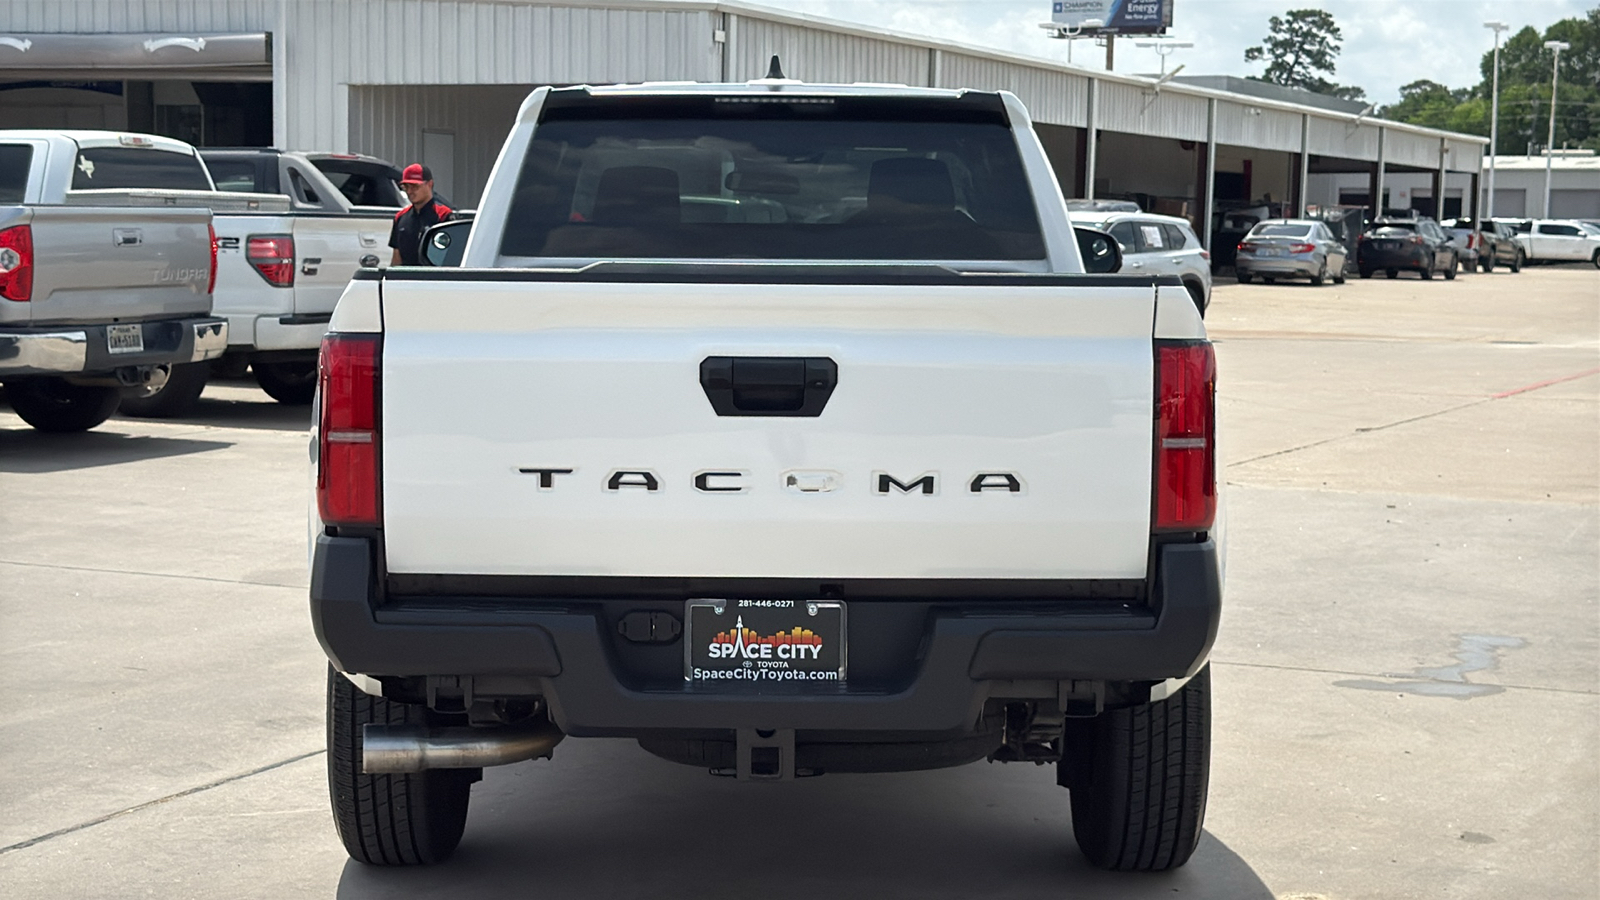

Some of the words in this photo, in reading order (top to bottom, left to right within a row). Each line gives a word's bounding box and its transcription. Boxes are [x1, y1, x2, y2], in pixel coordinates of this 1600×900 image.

[1127, 3, 1159, 14] Energy
[152, 268, 209, 283] TUNDRA
[517, 467, 1023, 495] TACOMA
[738, 599, 795, 608] 281-446-0271
[708, 643, 772, 659] SPACE
[777, 644, 823, 659] CITY
[756, 660, 790, 669] TOYOTA
[693, 668, 838, 681] SpaceCityToyota.com
